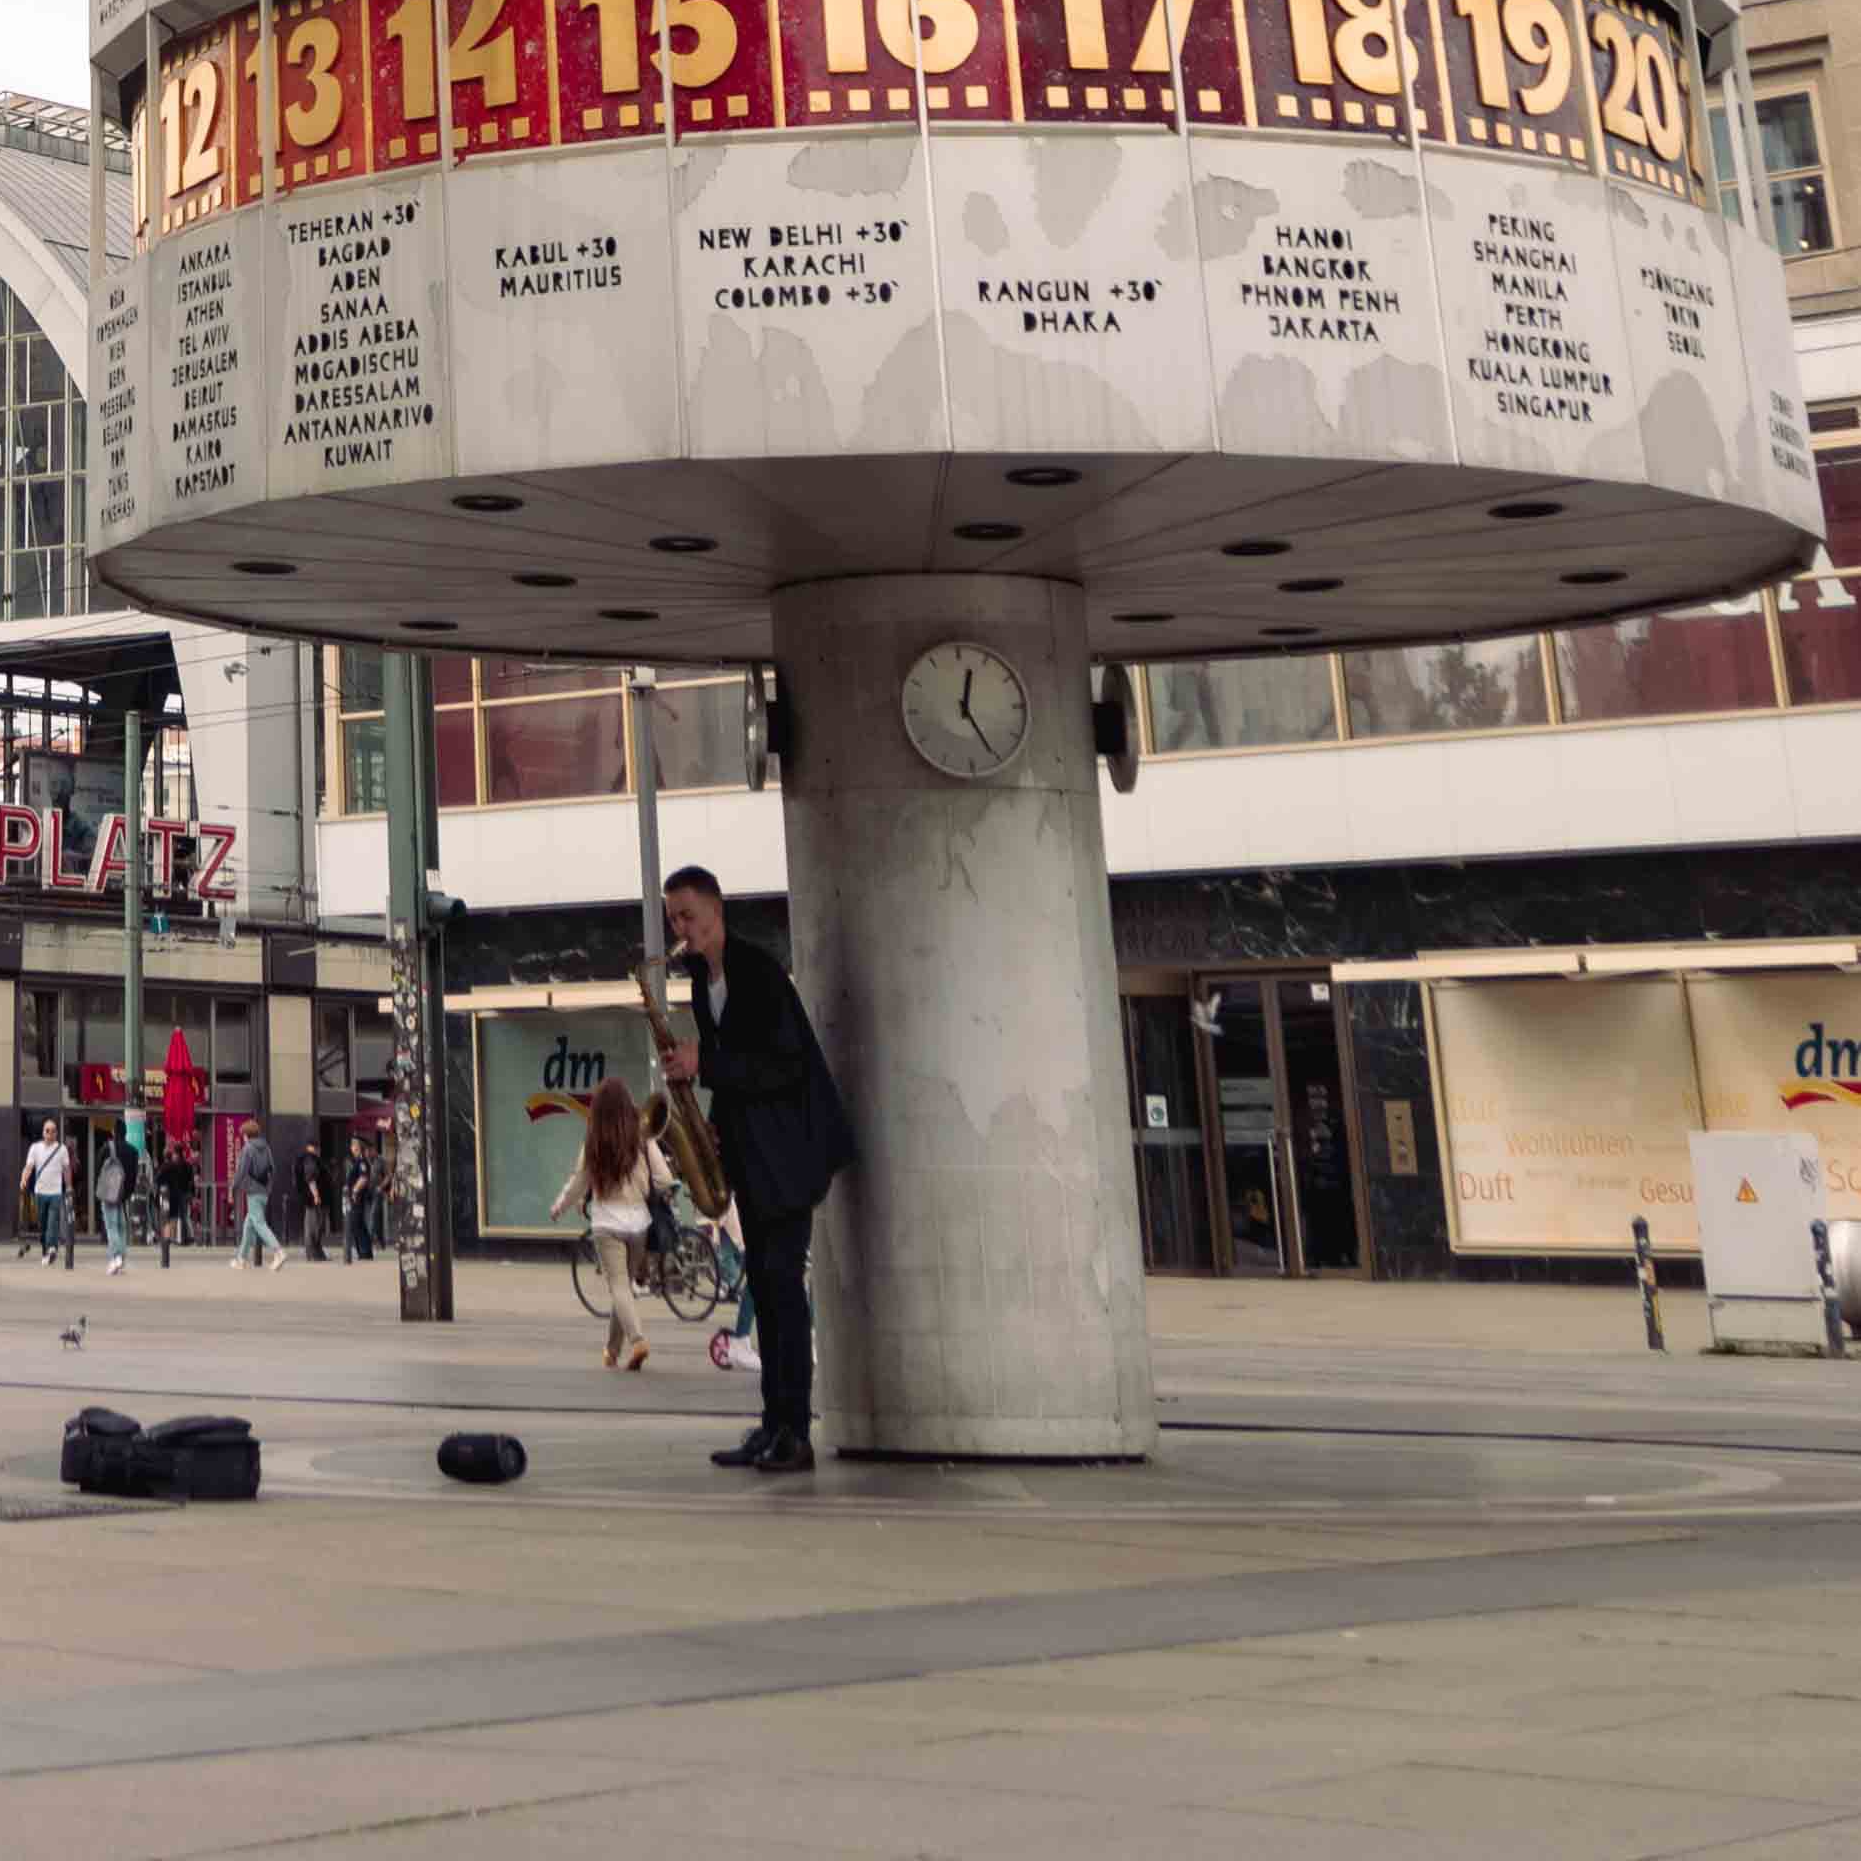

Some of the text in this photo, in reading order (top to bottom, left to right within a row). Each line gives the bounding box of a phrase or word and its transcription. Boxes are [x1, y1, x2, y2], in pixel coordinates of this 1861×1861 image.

[245, 17, 344, 158] 13
[1592, 11, 1685, 163] 20
[160, 60, 219, 198] 12
[287, 209, 374, 246] TEHERAN
[698, 227, 752, 250] NEW
[769, 224, 843, 248] DELHI
[1275, 226, 1353, 252] HANOI
[1487, 213, 1555, 243] PEKING
[178, 242, 232, 276] ANKARA
[318, 236, 392, 269] BAGDAD
[495, 241, 568, 270] KABUL
[743, 253, 866, 278] KARACHI
[1473, 240, 1578, 275] SHANGHAI
[330, 269, 382, 294] ADEN
[500, 266, 622, 299] MAURITIUS
[1262, 254, 1371, 283] BANGKOK
[177, 275, 232, 305] ISTANBUL
[714, 284, 832, 310] COLOMBO
[978, 280, 1091, 303] RANGUN
[1241, 284, 1401, 313] PHNOM PENH
[1491, 273, 1568, 303] MANILA
[186, 298, 224, 328] ATHEN
[320, 296, 389, 324] SANAA
[1022, 310, 1122, 334] DHAKA
[1504, 302, 1563, 331] PERTH
[1663, 301, 1700, 329] TOKYO
[179, 325, 230, 358] TEL AVIV
[293, 320, 419, 358] ADDIS ABEBA
[1269, 315, 1380, 344] JAKARTA
[1667, 330, 1706, 358] SEOUL
[1484, 330, 1591, 365] HONGKONG
[172, 350, 238, 388] JERUSALEM
[294, 347, 419, 386] MOGADISCHU
[1468, 358, 1613, 397] KUALA LUMPUR
[184, 381, 224, 411] BEIRUT
[294, 378, 421, 414] DARESSALAM
[1496, 392, 1595, 424] SINGAPUR
[173, 406, 237, 443] DAMASKUS
[283, 405, 435, 446] ANTANANARIVO
[186, 438, 222, 465] KAIRO
[323, 438, 394, 470] KUWAIT
[175, 463, 235, 500] KAPSTADT
[543, 1035, 605, 1089] dm
[1796, 1023, 1861, 1078] dm
[1459, 1171, 1515, 1202] Duft
